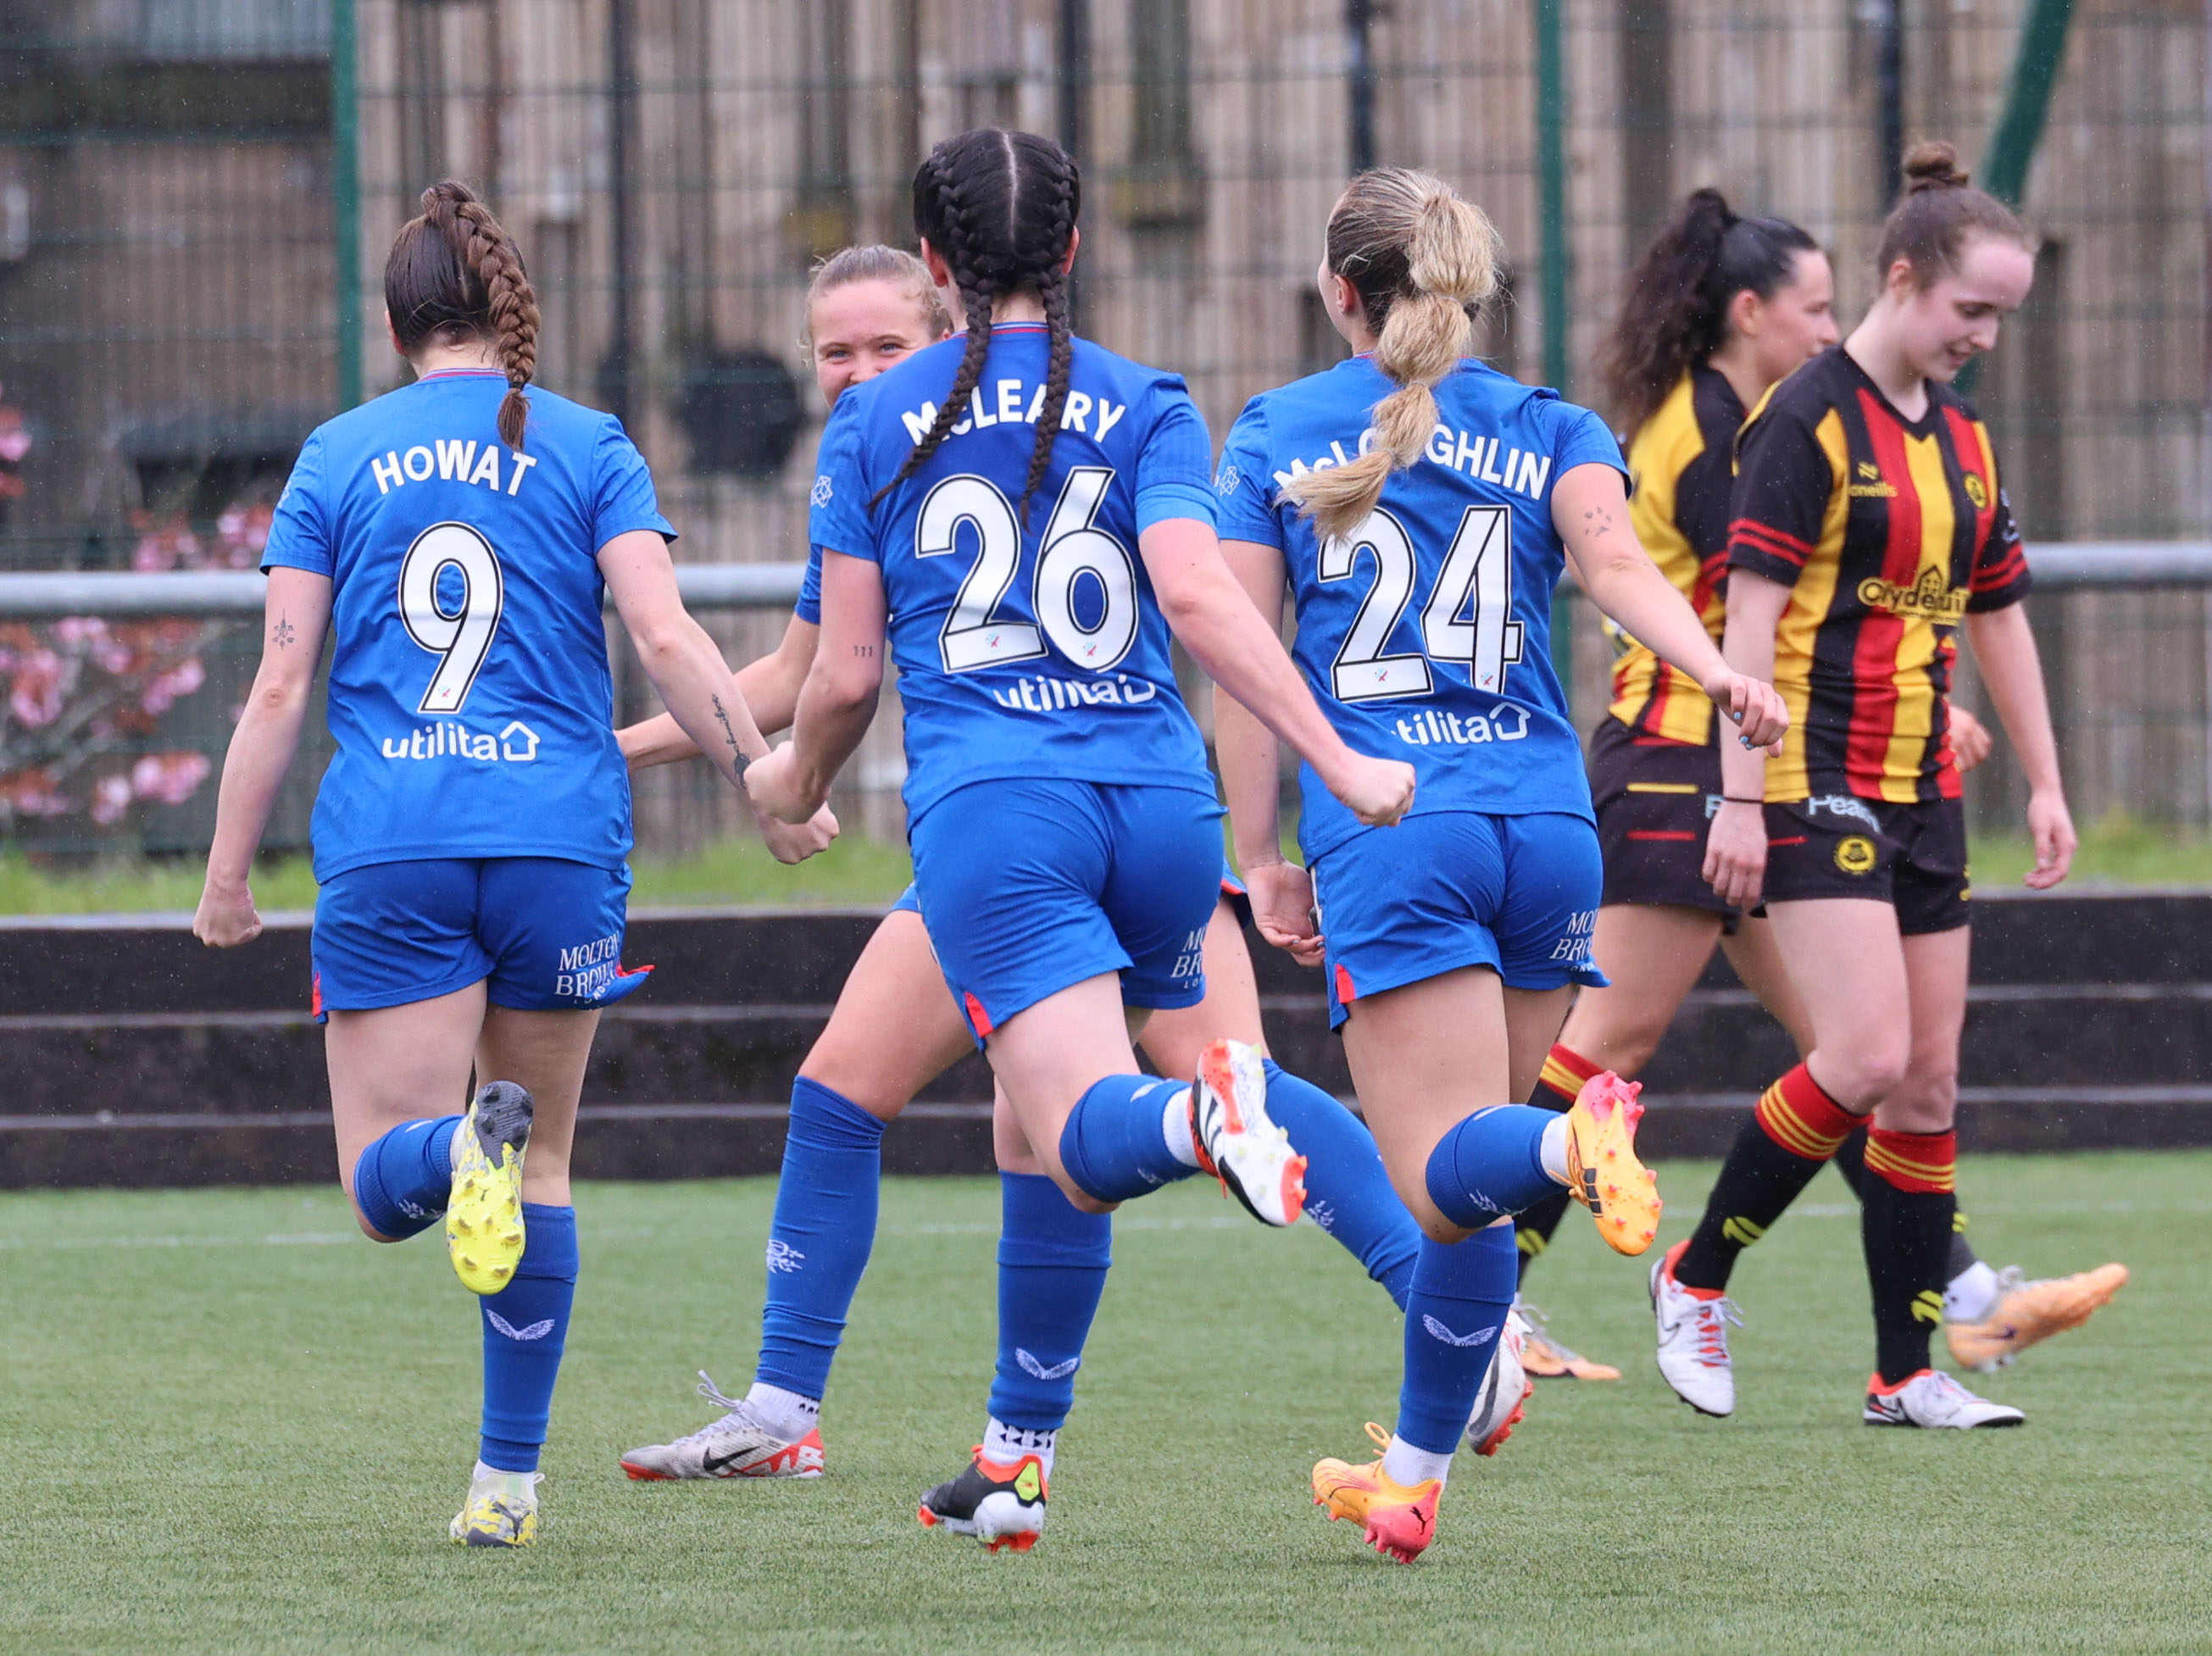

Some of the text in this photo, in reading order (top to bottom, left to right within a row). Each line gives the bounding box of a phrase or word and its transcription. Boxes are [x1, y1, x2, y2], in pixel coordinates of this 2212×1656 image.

[371, 439, 537, 497] HOWAT
[914, 465, 1139, 675] 26
[397, 520, 504, 714] 9
[1317, 504, 1524, 704] 24
[992, 675, 1123, 711] utilita
[381, 722, 499, 761] utilita
[1391, 710, 1493, 746] tilita
